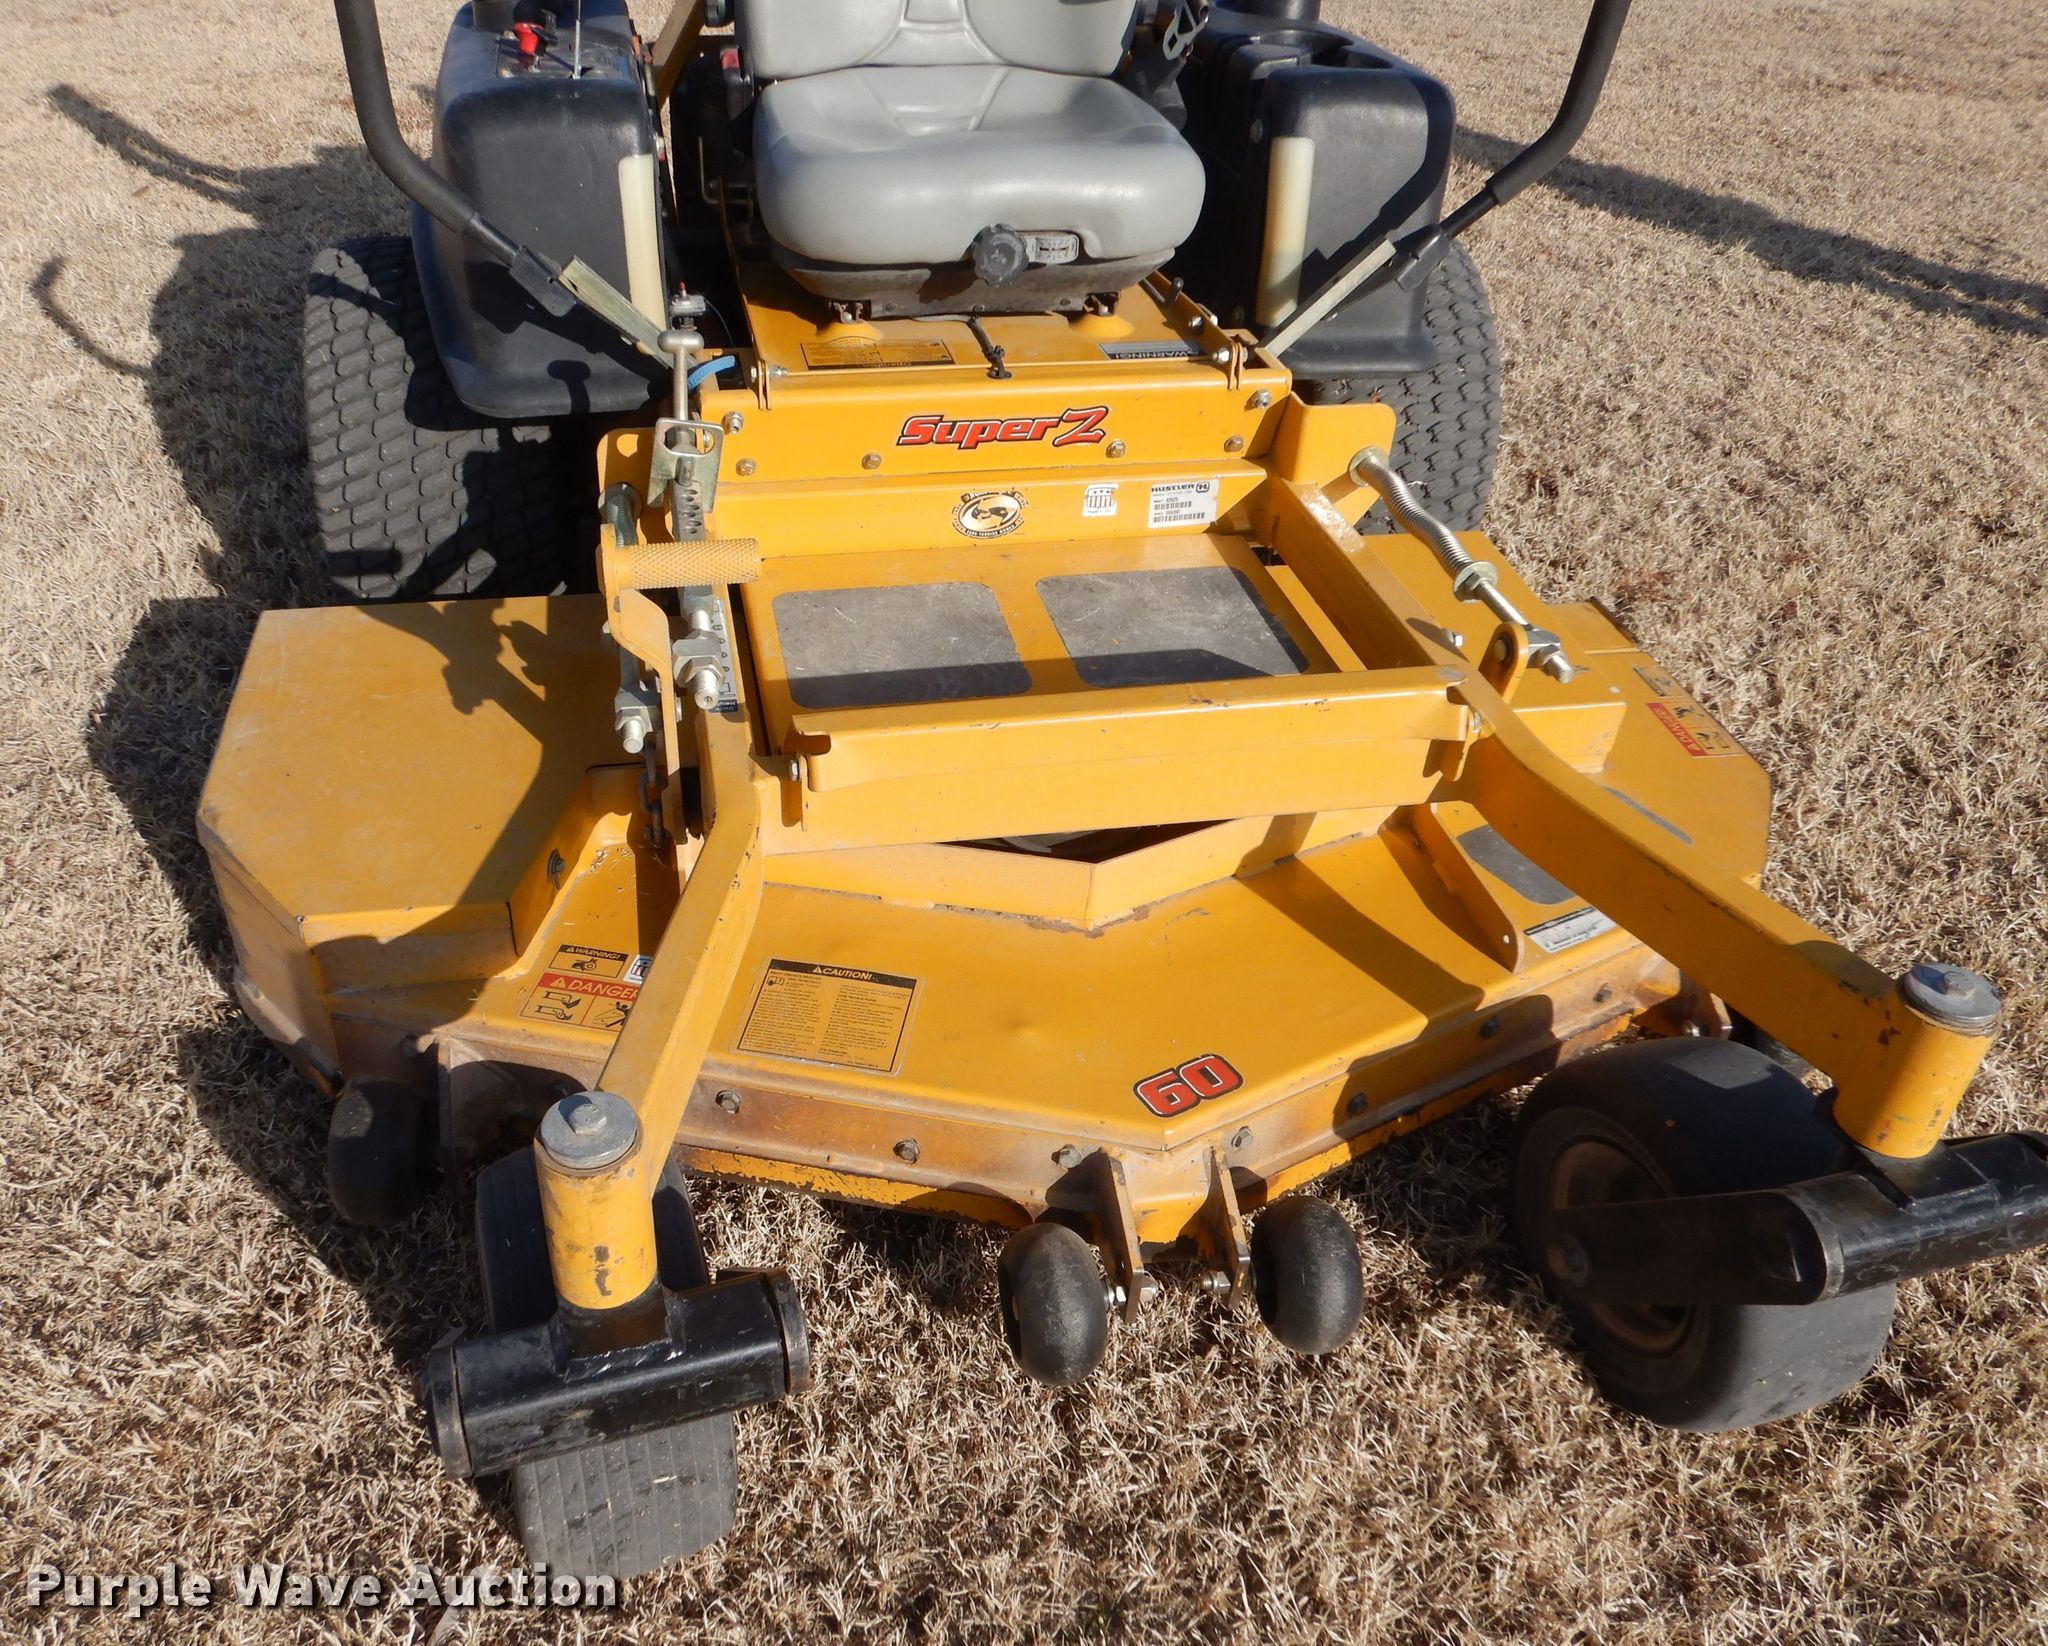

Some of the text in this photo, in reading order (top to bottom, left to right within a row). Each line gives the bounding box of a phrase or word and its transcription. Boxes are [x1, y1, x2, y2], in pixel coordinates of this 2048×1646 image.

[1115, 351, 1188, 359] WARNING!
[1151, 484, 1195, 492] HUSTLER
[574, 947, 621, 960] WARNING!
[821, 967, 873, 981] CAUTION!
[1133, 1053, 1243, 1118] 60
